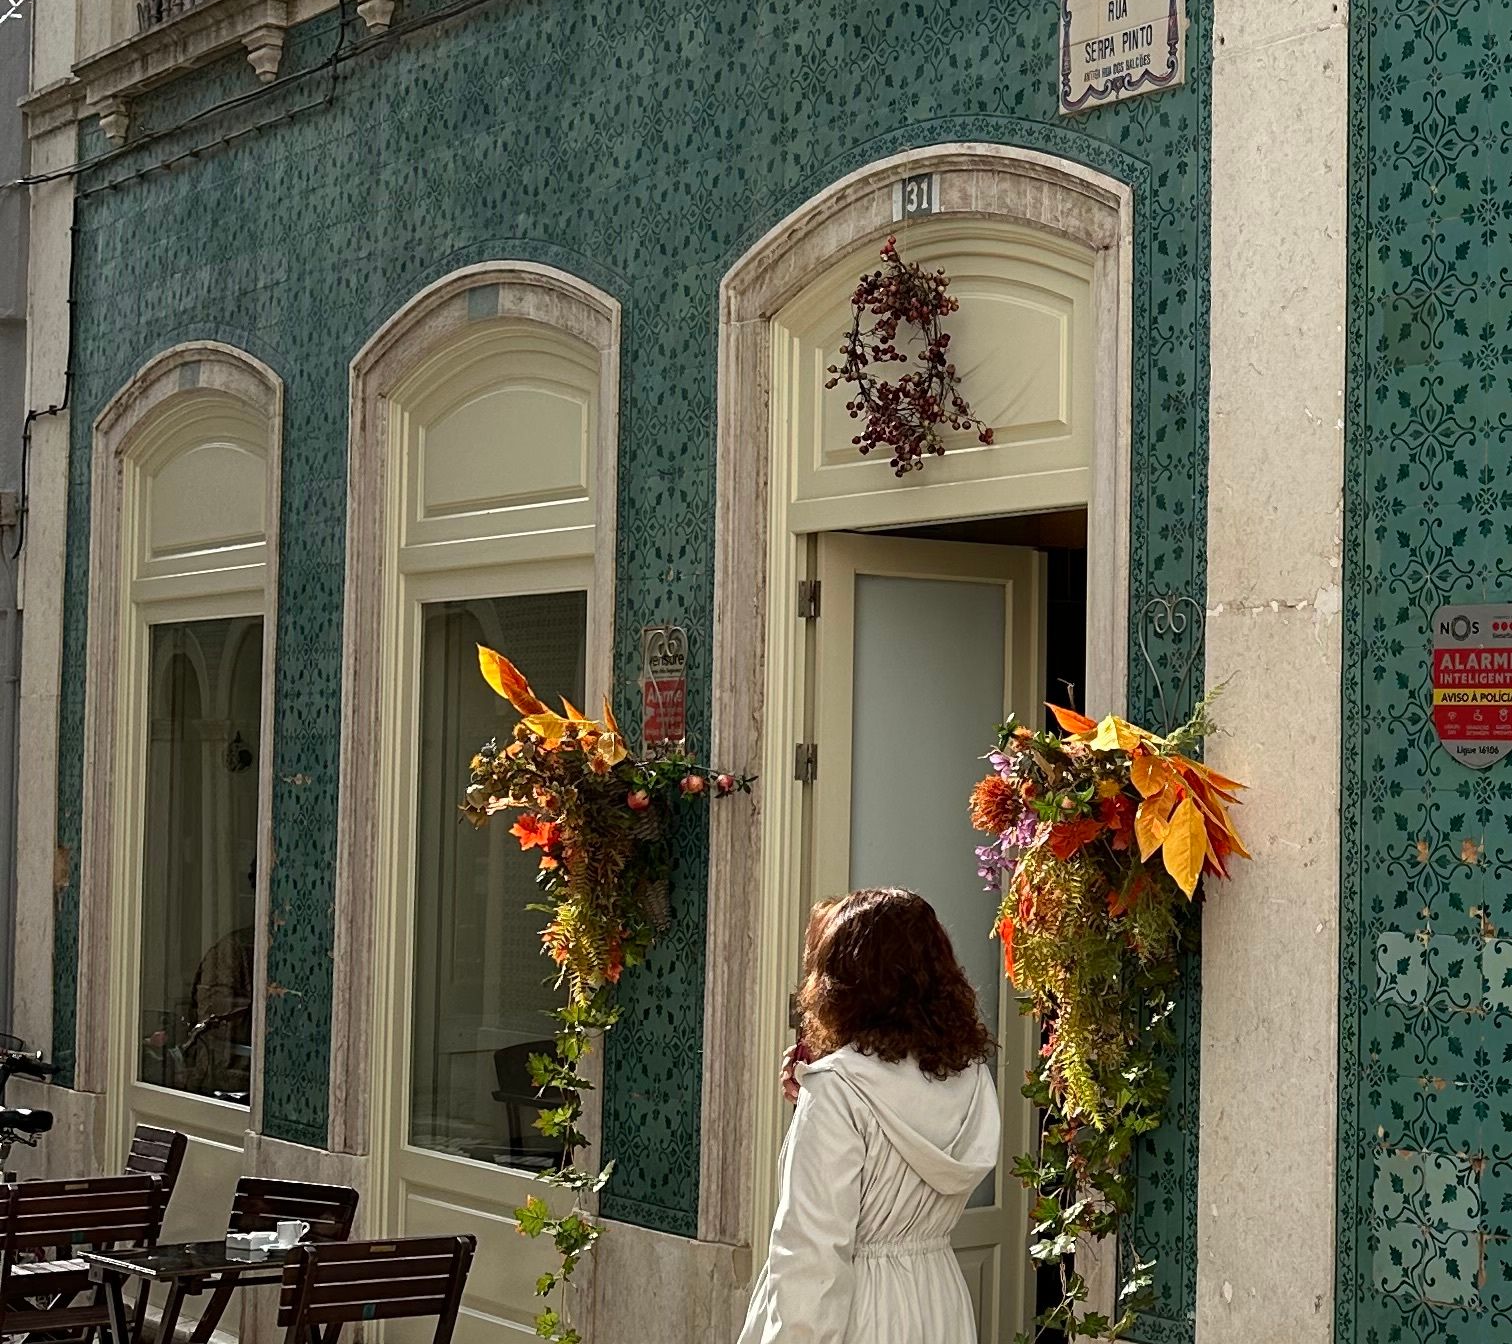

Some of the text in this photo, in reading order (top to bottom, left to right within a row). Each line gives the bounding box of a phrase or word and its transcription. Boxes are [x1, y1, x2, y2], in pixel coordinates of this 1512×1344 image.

[1085, 24, 1153, 63] SERPA PINTO
[906, 178, 929, 213] 31
[1440, 615, 1480, 641] NOS
[1441, 692, 1469, 703] AVISO
[1457, 746, 1476, 756] Ligue
